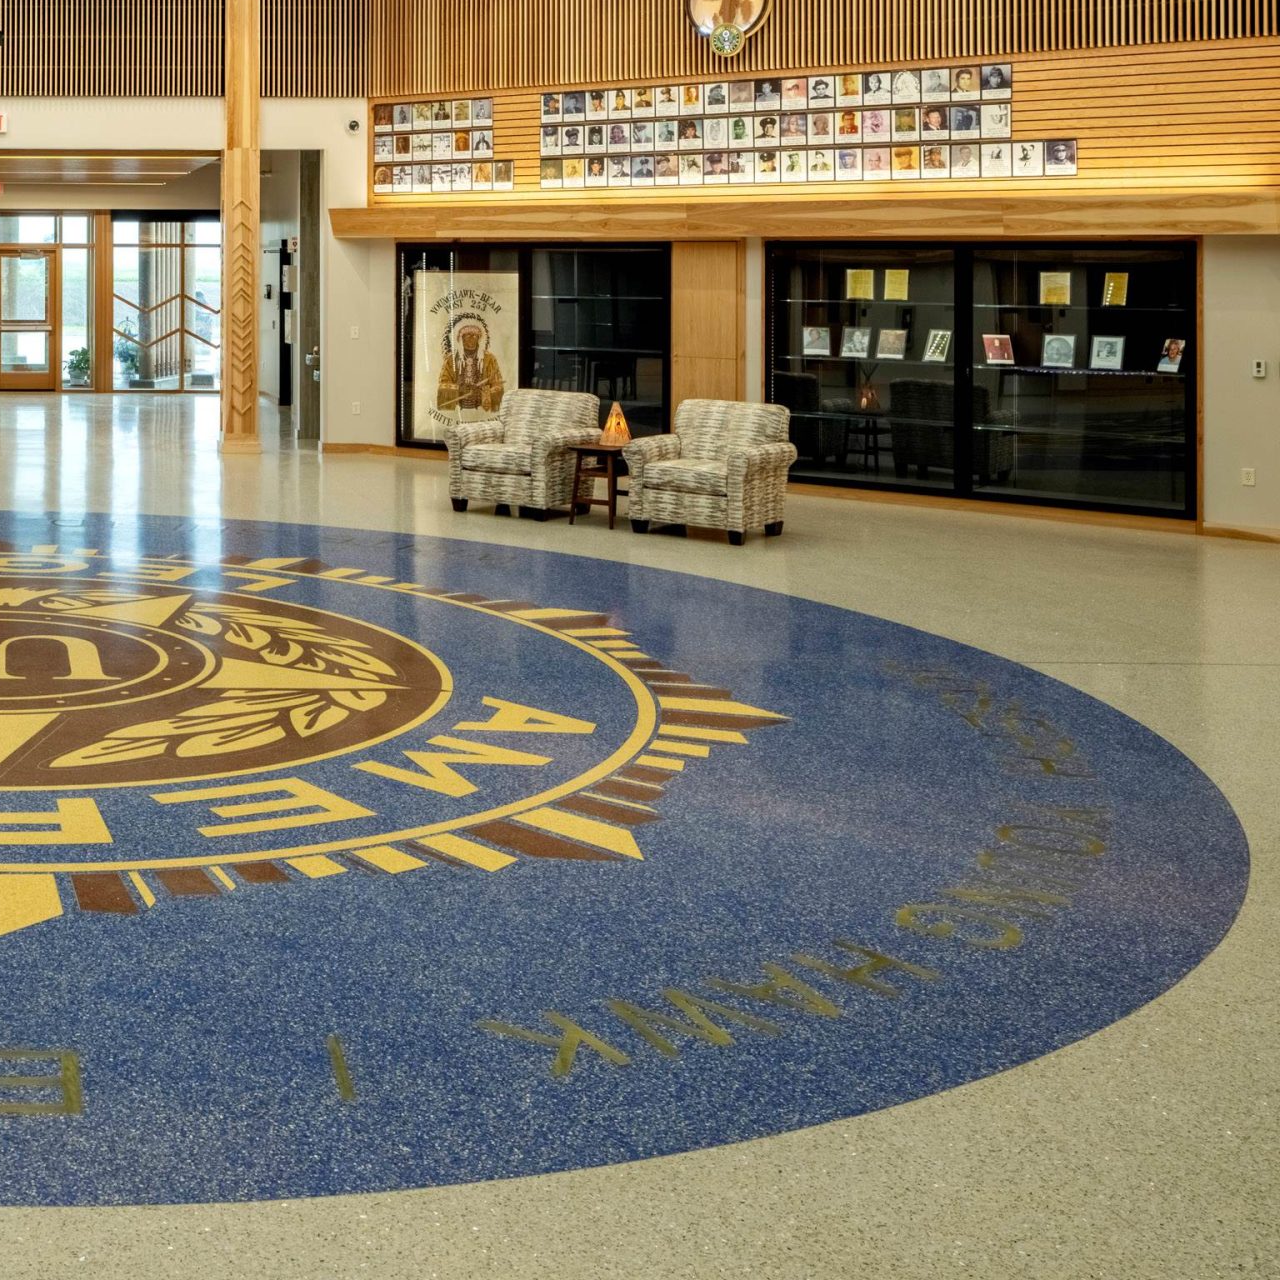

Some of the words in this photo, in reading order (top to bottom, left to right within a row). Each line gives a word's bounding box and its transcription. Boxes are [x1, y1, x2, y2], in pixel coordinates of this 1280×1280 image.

[444, 299, 463, 314] POST
[470, 299, 487, 312] 253
[477, 938, 941, 1081] HAWK
